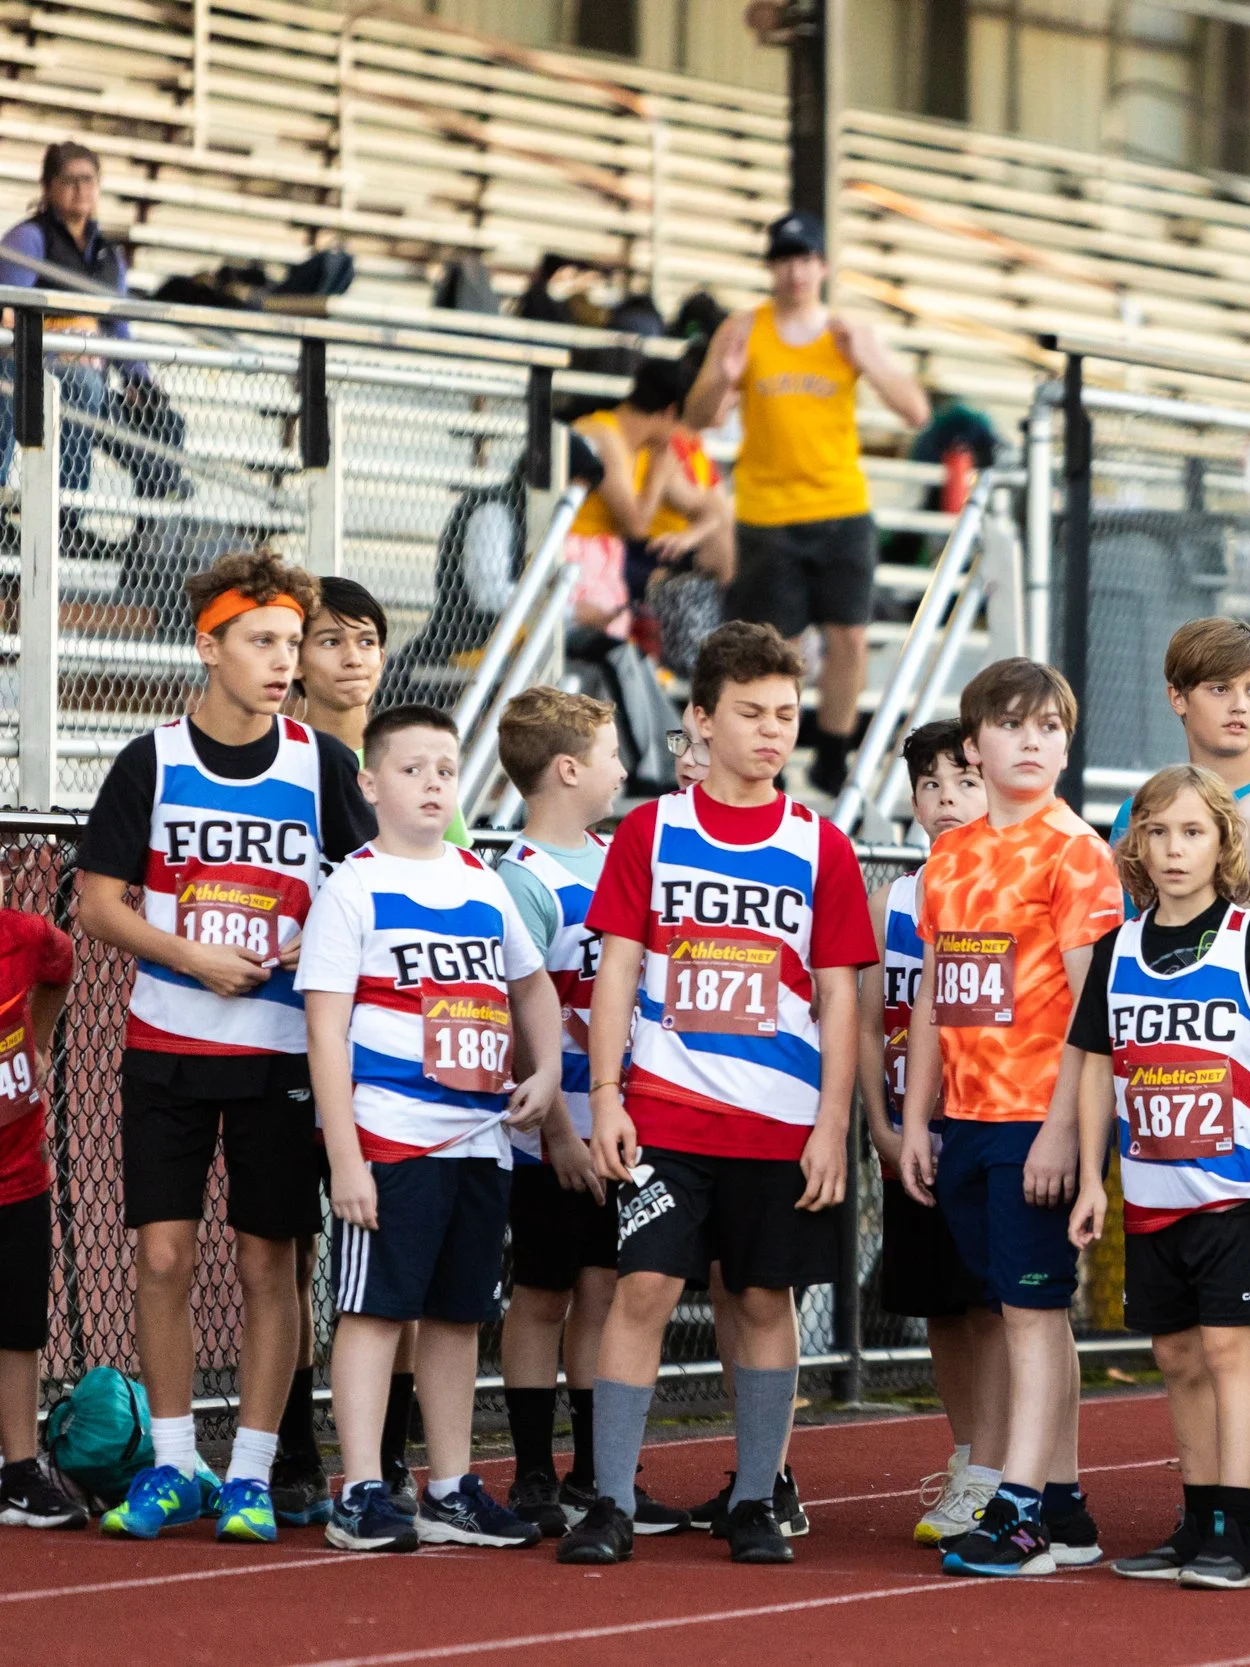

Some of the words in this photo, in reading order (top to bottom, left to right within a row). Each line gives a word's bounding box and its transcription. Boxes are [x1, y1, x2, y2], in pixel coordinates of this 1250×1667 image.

[164, 820, 307, 866] FGRC
[178, 883, 252, 906] Athletic
[661, 880, 803, 935] FGRC
[183, 909, 270, 959] 1888
[672, 940, 747, 961] Athletic
[675, 968, 766, 1015] 1871
[936, 962, 1005, 1005] 1894
[1113, 1001, 1238, 1048] FGRC
[434, 1027, 511, 1073] 1887
[0, 1051, 32, 1100] 49
[1131, 1066, 1199, 1086] Athletic
[1133, 1092, 1224, 1138] 1872
[619, 1193, 677, 1241] MOUR
